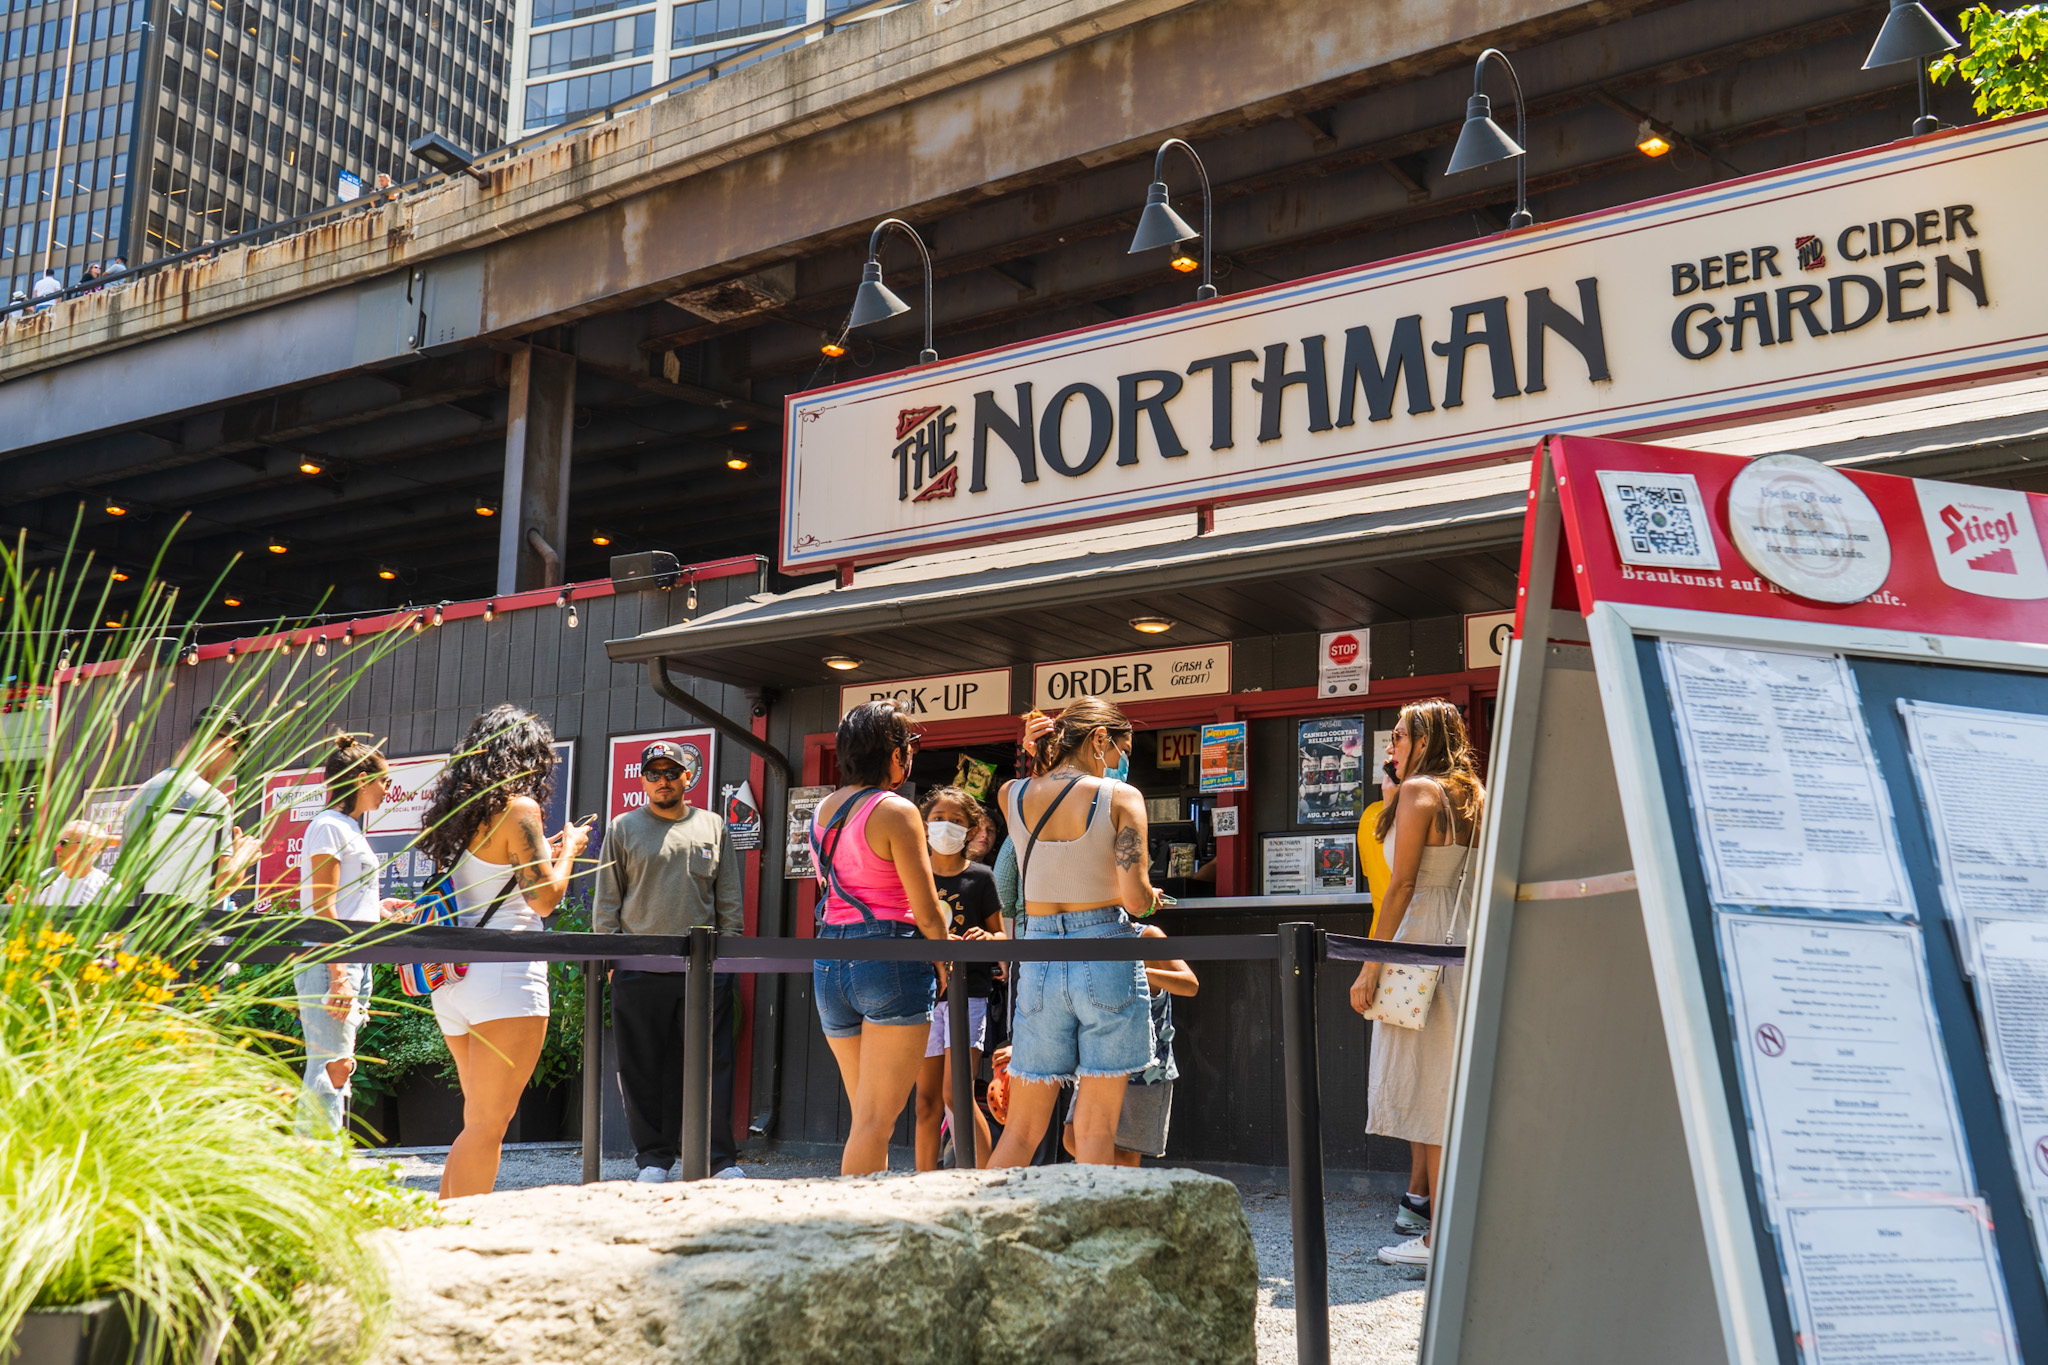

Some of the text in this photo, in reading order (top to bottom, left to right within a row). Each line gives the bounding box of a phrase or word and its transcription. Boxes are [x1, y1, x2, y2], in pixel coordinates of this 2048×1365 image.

[1671, 204, 1978, 297] BEER AND CIDER
[1671, 249, 1990, 360] GARDEN
[892, 276, 1611, 501] THE NORTHMAN
[1760, 487, 1842, 504] Use the QR code
[1939, 504, 2018, 555] Stiegl
[1766, 543, 1781, 553] for
[1821, 547, 1840, 557] and
[1620, 564, 1724, 588] Braukunst
[1730, 577, 1762, 592] auf
[1331, 644, 1357, 656] STOP
[1205, 659, 1214, 669] &
[1048, 664, 1154, 700] ORDER
[1163, 734, 1197, 761] EXIT
[385, 785, 418, 803] ollow
[623, 792, 650, 807] YOU
